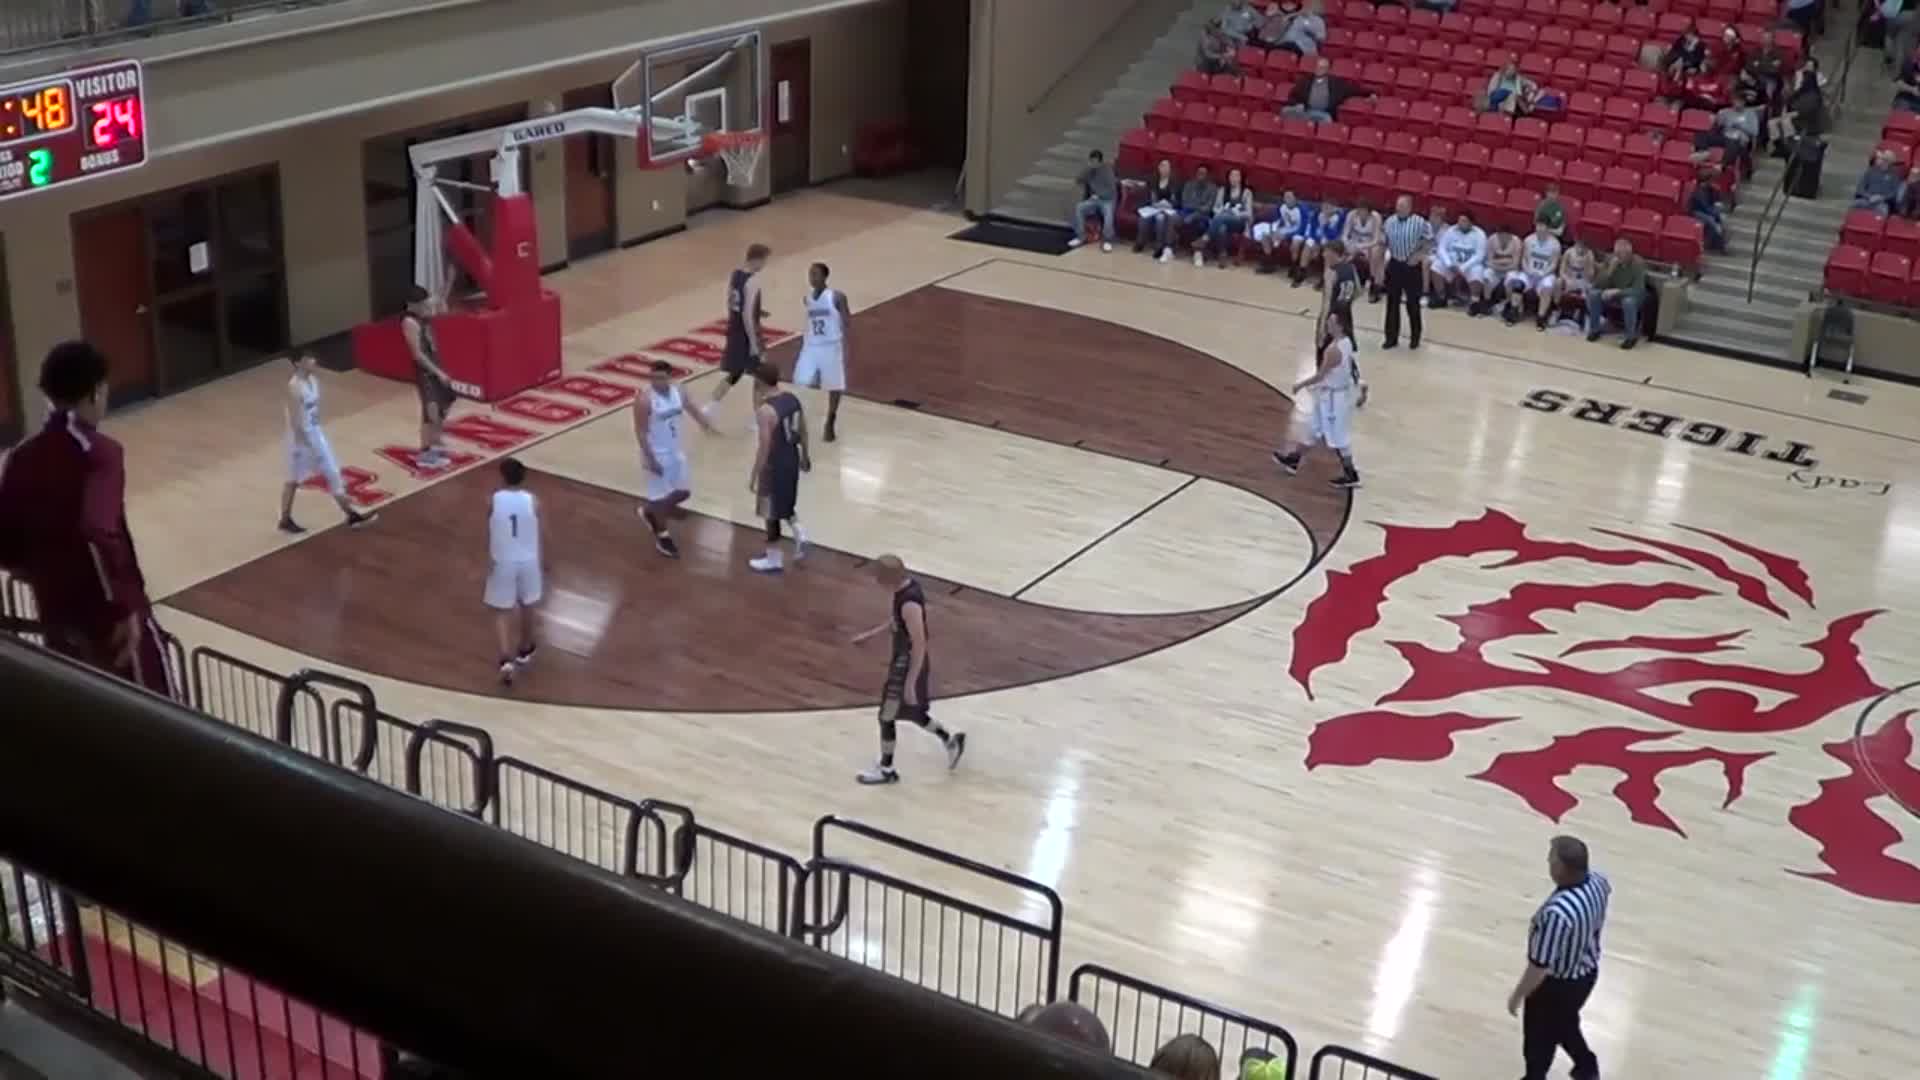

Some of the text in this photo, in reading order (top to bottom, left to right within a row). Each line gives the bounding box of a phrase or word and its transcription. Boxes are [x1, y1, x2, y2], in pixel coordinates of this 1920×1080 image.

[75, 69, 137, 99] VISITOR
[91, 96, 139, 147] 24
[512, 121, 566, 141] GARED
[29, 149, 50, 186] 2
[80, 149, 119, 170] BONUS
[1518, 387, 1820, 468] TIGERS
[1785, 468, 1893, 498] Lady
[509, 513, 518, 538] 1
